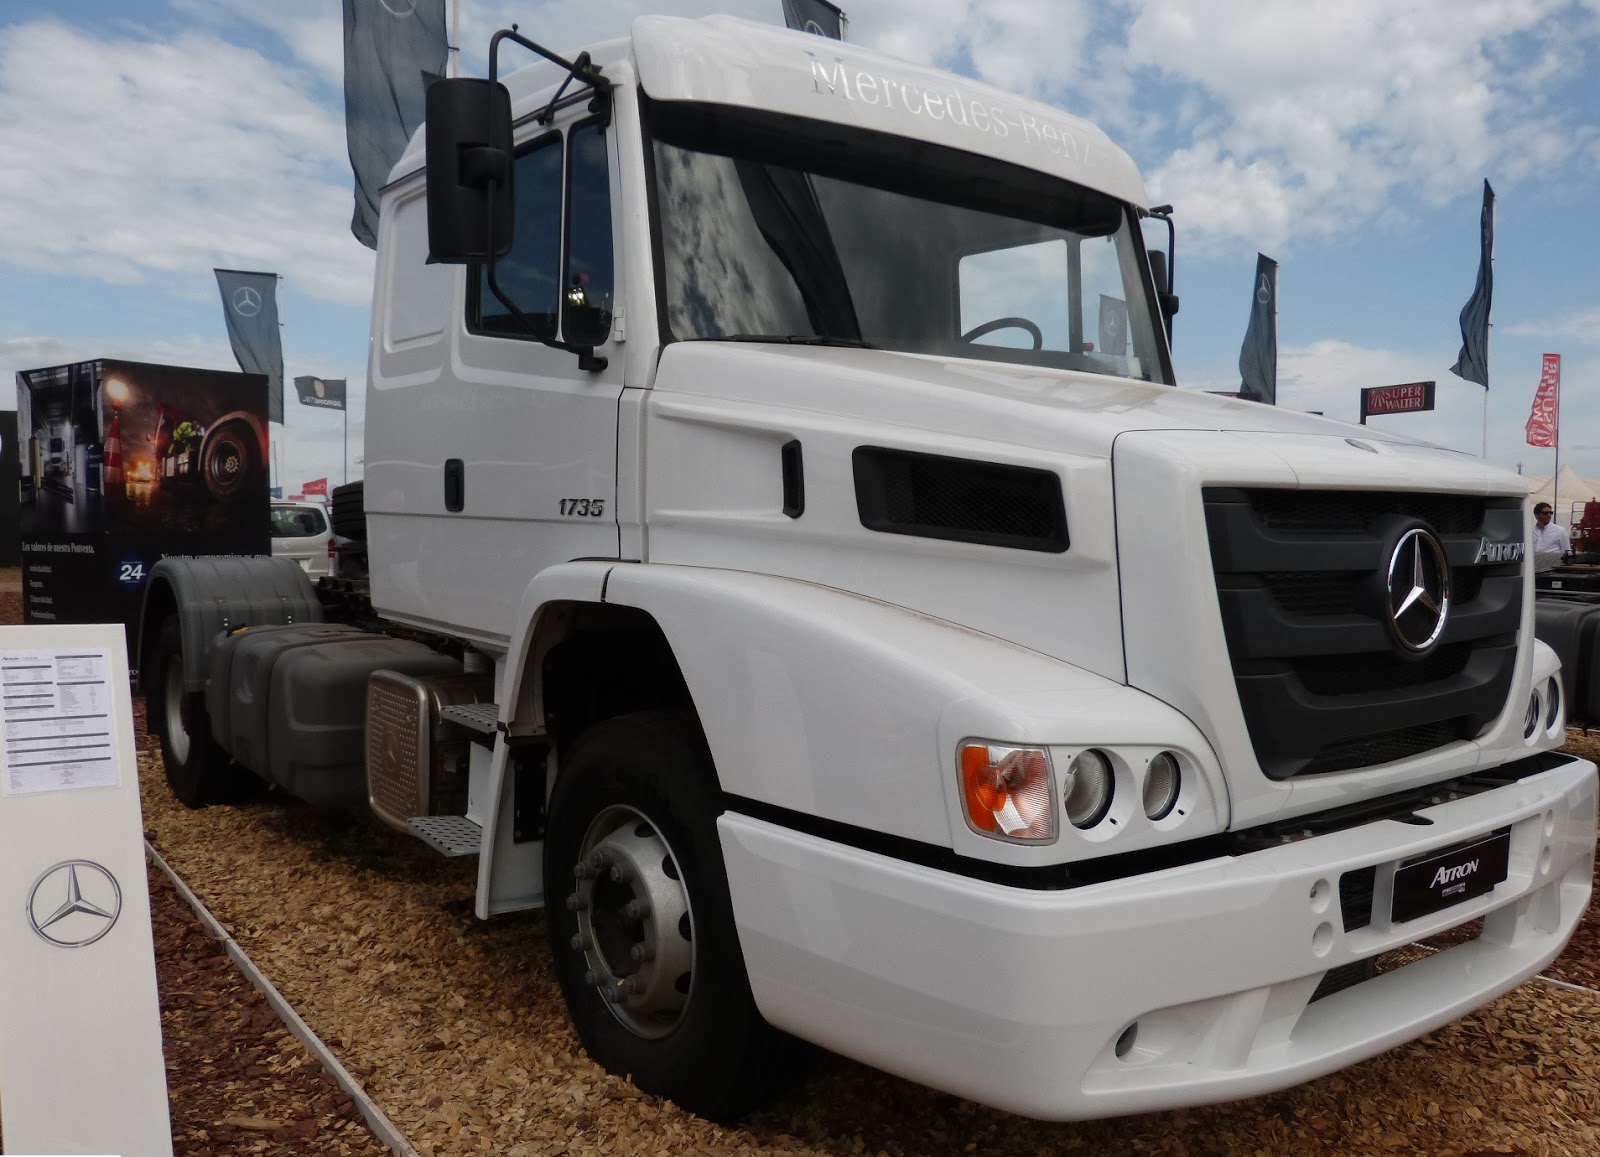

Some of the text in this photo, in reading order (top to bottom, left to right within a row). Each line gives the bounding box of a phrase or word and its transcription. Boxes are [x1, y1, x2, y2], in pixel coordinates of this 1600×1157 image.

[1385, 386, 1421, 399] SUPER
[1385, 397, 1420, 410] WALTER
[559, 498, 605, 516] 1735
[1474, 536, 1525, 564] ATRON
[1429, 858, 1480, 889] ATRON
